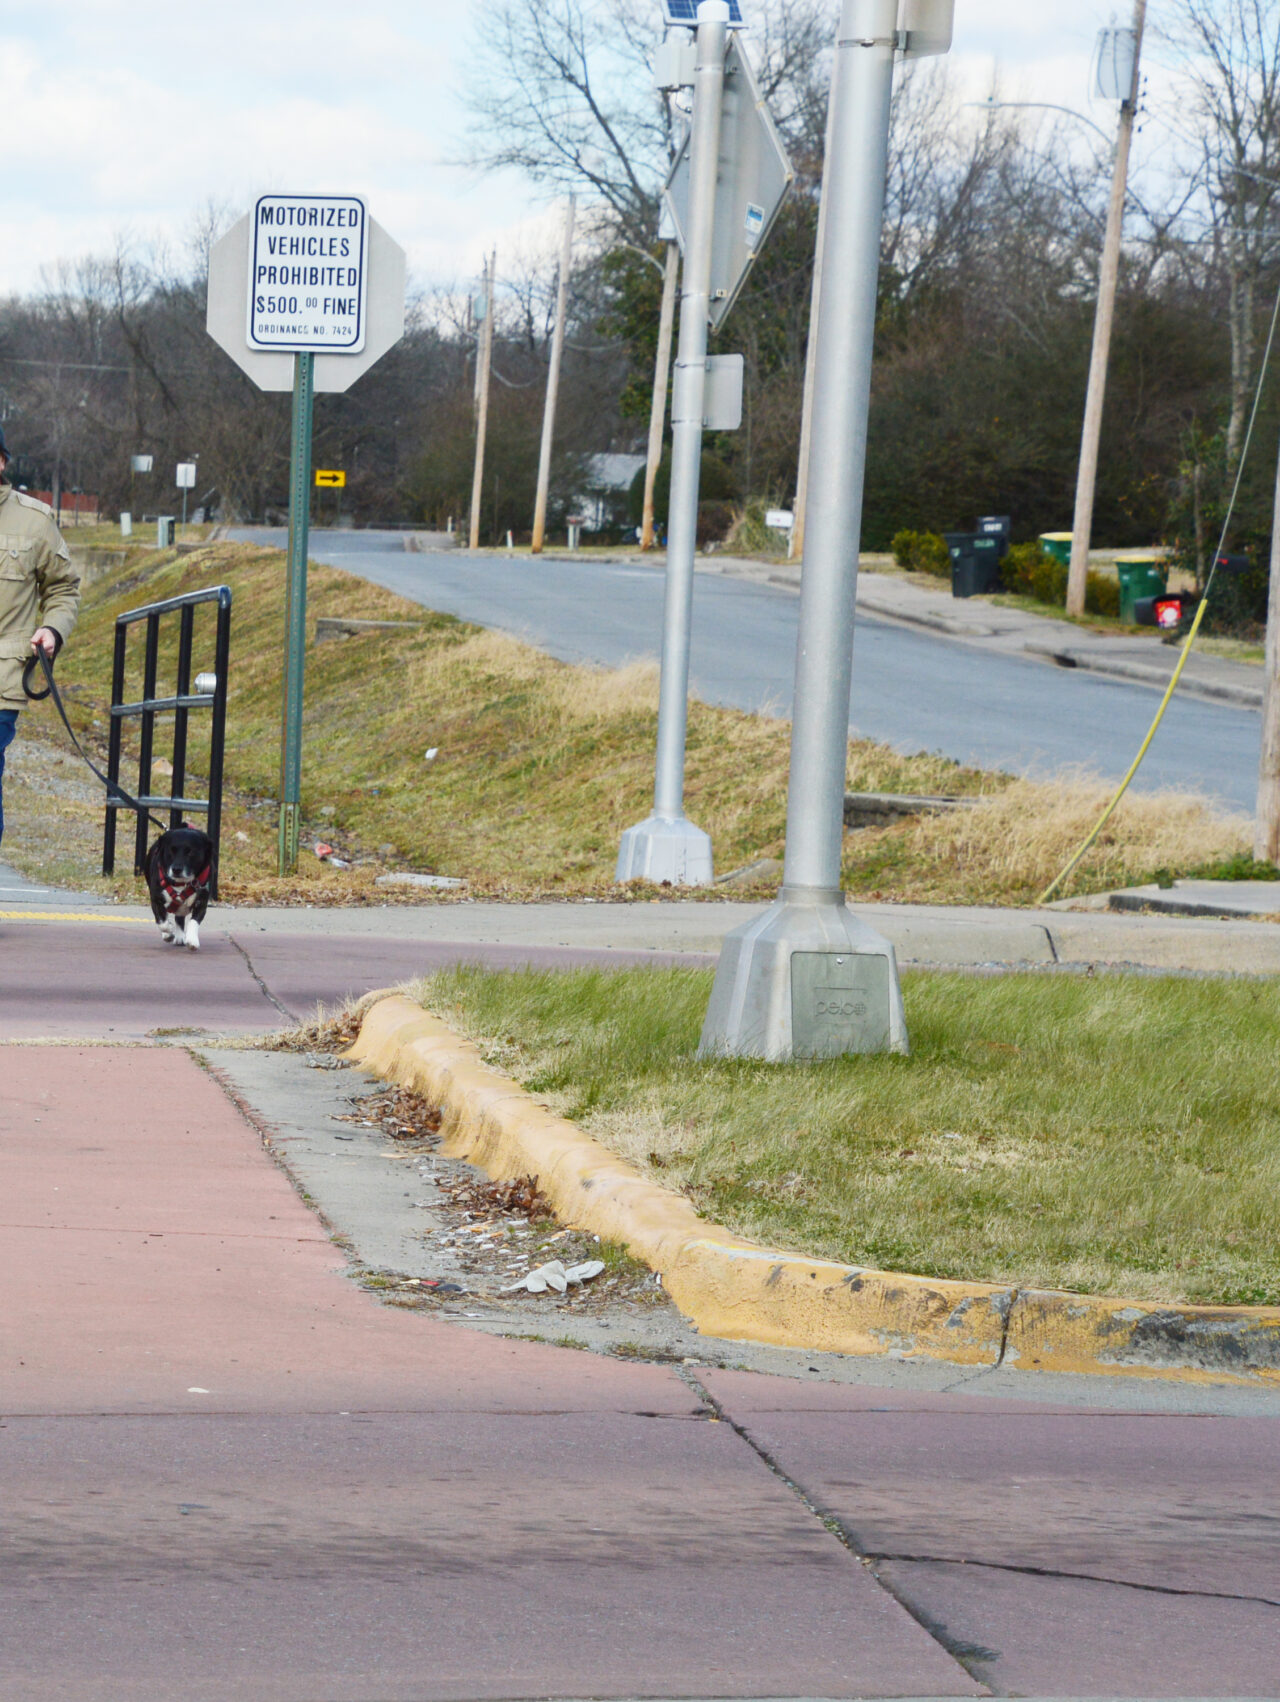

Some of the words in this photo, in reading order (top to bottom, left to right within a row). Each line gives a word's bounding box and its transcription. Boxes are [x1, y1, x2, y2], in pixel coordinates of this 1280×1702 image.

[260, 206, 358, 227] MOTORIZED
[268, 236, 350, 257] VEHICLES
[257, 265, 357, 286] PROHIBITED
[323, 297, 357, 315] FINE
[258, 324, 309, 335] ORDINANCE
[332, 326, 352, 336] 7424
